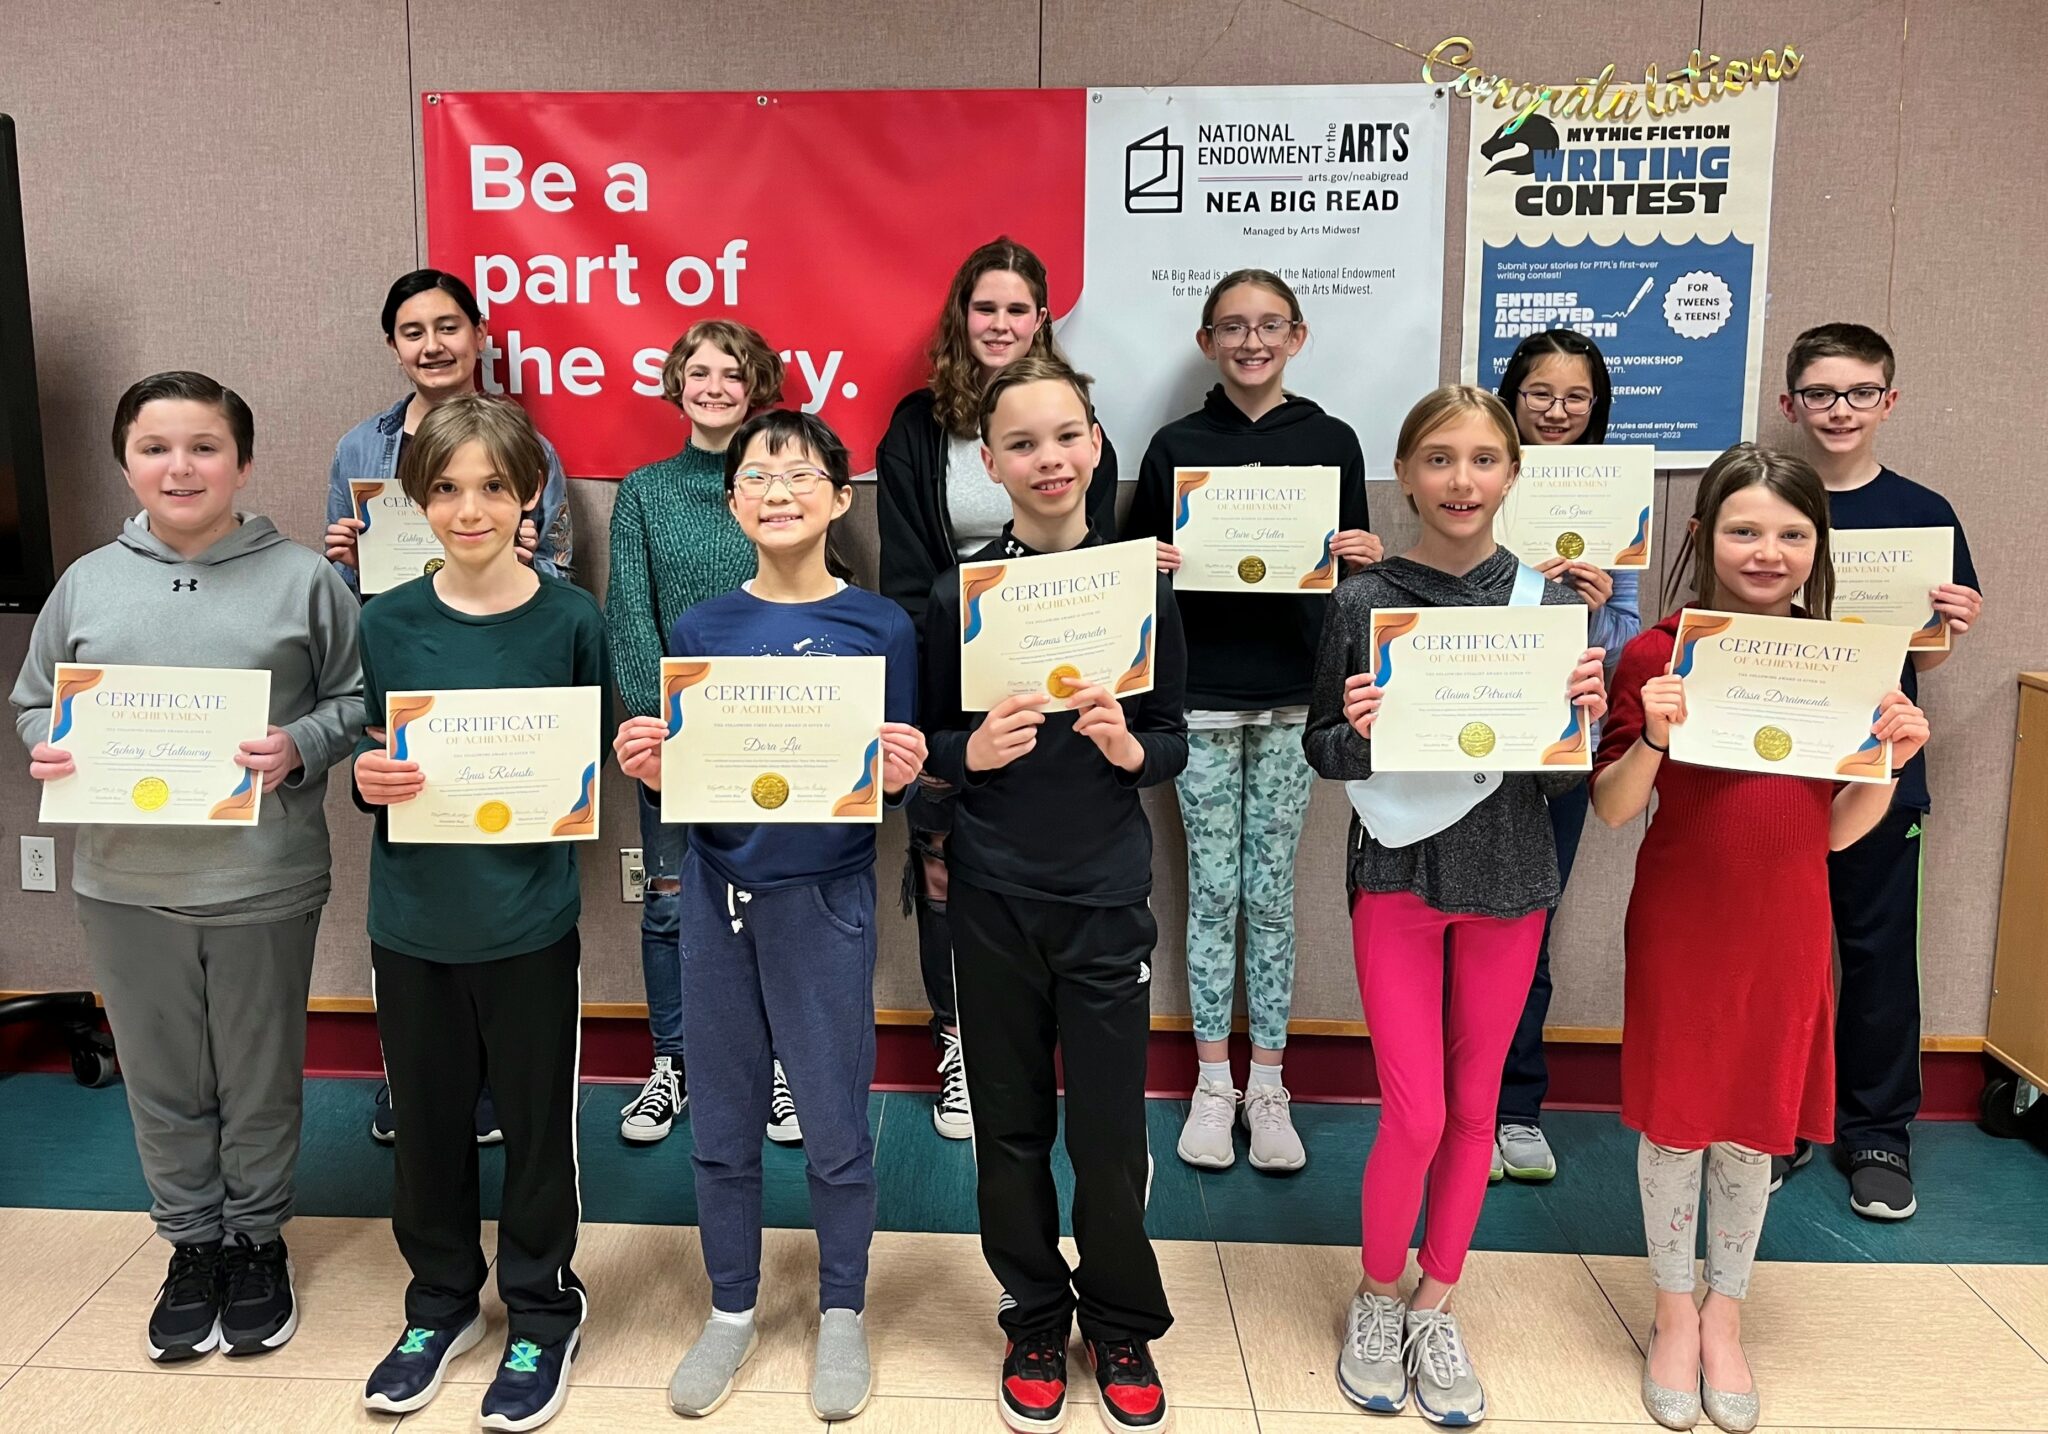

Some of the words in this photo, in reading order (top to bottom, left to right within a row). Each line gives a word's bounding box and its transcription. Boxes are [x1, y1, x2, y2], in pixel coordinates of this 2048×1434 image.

[1421, 36, 1805, 135] Congratulations
[1199, 124, 1295, 143] NATIONAL
[1327, 122, 1336, 139] the
[1567, 127, 1642, 142] MYTHIC
[1646, 124, 1730, 141] FICTION
[1338, 122, 1410, 163] ARTS
[1198, 145, 1323, 165] ENDOWMENT
[1325, 141, 1336, 163] for
[1533, 146, 1731, 183] WRITING
[470, 144, 577, 213] Be
[603, 161, 649, 213] a
[1308, 172, 1409, 183] arts.gov/neabigread
[1206, 191, 1260, 213] NEA
[1270, 190, 1316, 213] BIG
[1326, 189, 1399, 212] READ
[1515, 182, 1728, 217] CONTEST
[1243, 227, 1285, 237] Managed
[1287, 226, 1298, 236] by
[1300, 226, 1320, 235] Arts
[1322, 225, 1360, 235] Midwest
[1497, 262, 1527, 271] Submit
[1529, 263, 1548, 273] your
[1550, 261, 1578, 270] stories
[1580, 261, 1592, 270] for
[1619, 260, 1658, 269] first-ever
[474, 244, 640, 318] part
[665, 238, 748, 306] of
[1152, 270, 1169, 281] NEA
[1171, 270, 1186, 283] Big
[1188, 269, 1211, 281] Read
[1213, 269, 1221, 280] is
[1284, 268, 1299, 279] the
[1302, 267, 1340, 279] National
[1341, 267, 1396, 279] Endowment
[1496, 271, 1526, 281] writing
[1527, 270, 1562, 280] contest!
[1172, 285, 1185, 296] for
[1187, 285, 1202, 296] the
[1312, 284, 1330, 295] Arts
[1332, 283, 1373, 295] Midwest.
[1687, 283, 1709, 292] FOR
[1495, 292, 1578, 308] ENTRIES
[1677, 297, 1720, 307] TWEENS
[1494, 307, 1595, 323] ACCEPTED
[1674, 312, 1682, 321] &
[1684, 311, 1720, 321] TEENS!
[481, 330, 605, 396] the
[1623, 355, 1684, 365] WORKSHOP
[1611, 385, 1663, 395] EREMONY
[1521, 466, 1622, 479] CERTIFICATE
[1205, 488, 1307, 502] CERTIFICATE
[1832, 550, 1913, 564] TIFICATE
[1001, 570, 1121, 602] CERTIFICATE
[1018, 602, 1031, 613] OF
[1035, 592, 1106, 612] ACHIEVEMENT
[1019, 634, 1060, 650] Thomas
[1412, 633, 1545, 651] CERTIFICATE
[1719, 637, 1861, 663] CERTIFICATE
[1429, 654, 1443, 664] OF
[1447, 653, 1527, 664] ACHIEVEMENT
[1733, 655, 1747, 665] OF
[1751, 658, 1839, 673] ACHIEVEMENT
[96, 691, 227, 710] CERTIFICATE
[704, 685, 841, 702] CERTIFICATE
[111, 710, 126, 720] OF
[129, 710, 209, 722] ACHIEVEMENT
[721, 704, 736, 714] OF
[740, 704, 824, 715] ACHIEVEMENT
[429, 714, 560, 733] CERTIFICATE
[446, 736, 461, 746] OF
[464, 733, 544, 745] ACHIEVEMENT
[743, 737, 777, 752] Dora
[102, 741, 146, 760] Zachary
